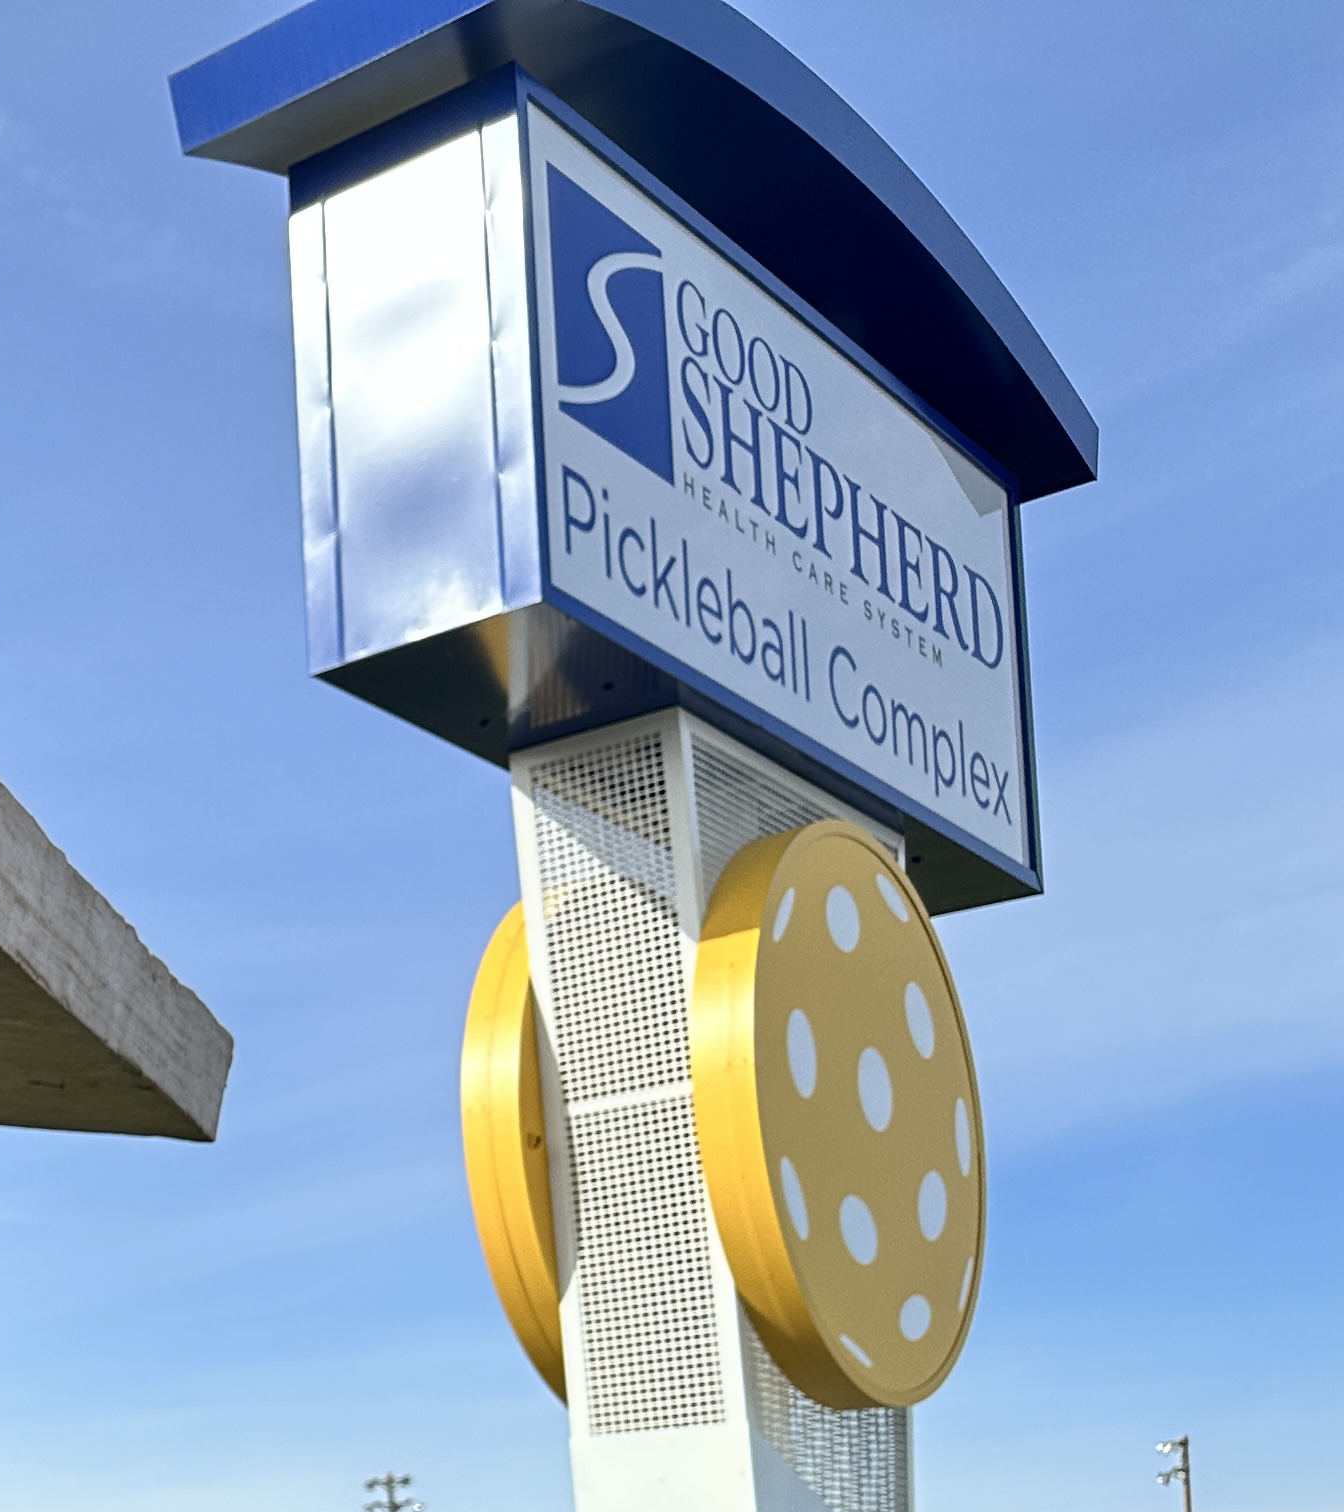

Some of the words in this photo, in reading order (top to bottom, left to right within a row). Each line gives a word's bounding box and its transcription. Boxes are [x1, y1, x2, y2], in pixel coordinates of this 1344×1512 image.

[676, 280, 813, 435] GOOD
[681, 356, 1004, 669] SHEPHERD
[683, 472, 777, 556] HEALTH
[792, 550, 849, 604] CARE
[863, 601, 944, 668] SYSTEM
[562, 464, 811, 702] Pickleball
[828, 645, 1012, 825] Complex
